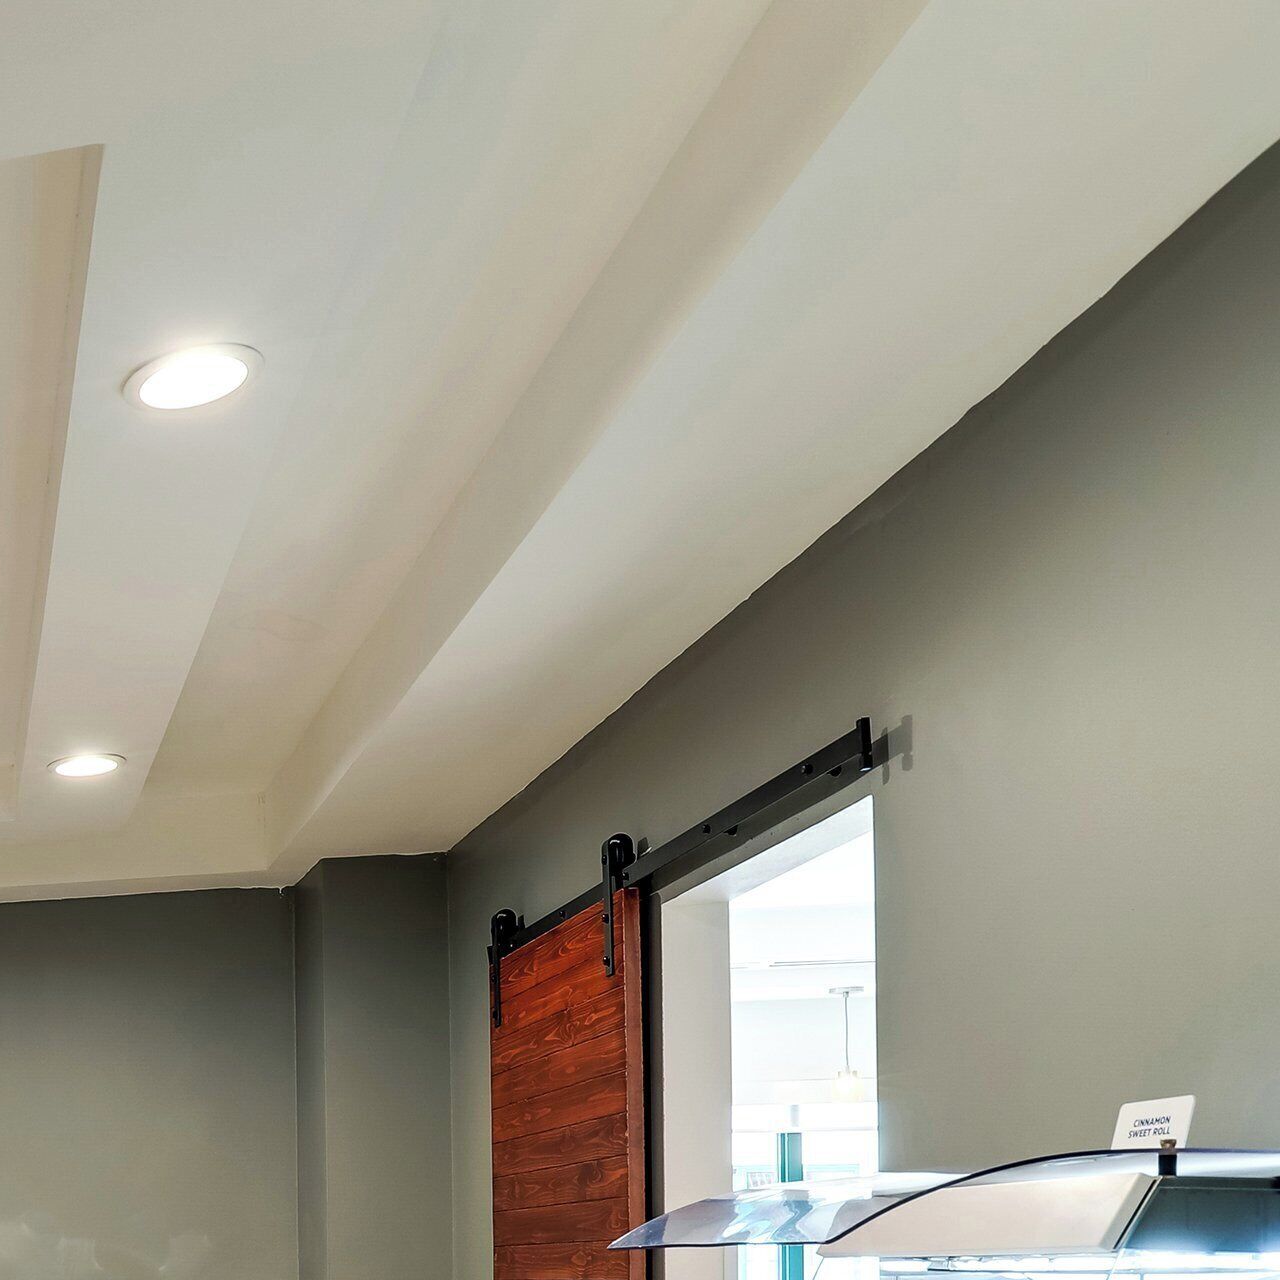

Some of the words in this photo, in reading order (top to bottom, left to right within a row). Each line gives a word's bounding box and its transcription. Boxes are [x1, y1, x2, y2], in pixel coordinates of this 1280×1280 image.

[1133, 1116, 1171, 1127] CINNAMON
[1128, 1128, 1151, 1139] SWEET
[1153, 1127, 1170, 1136] ROLL
